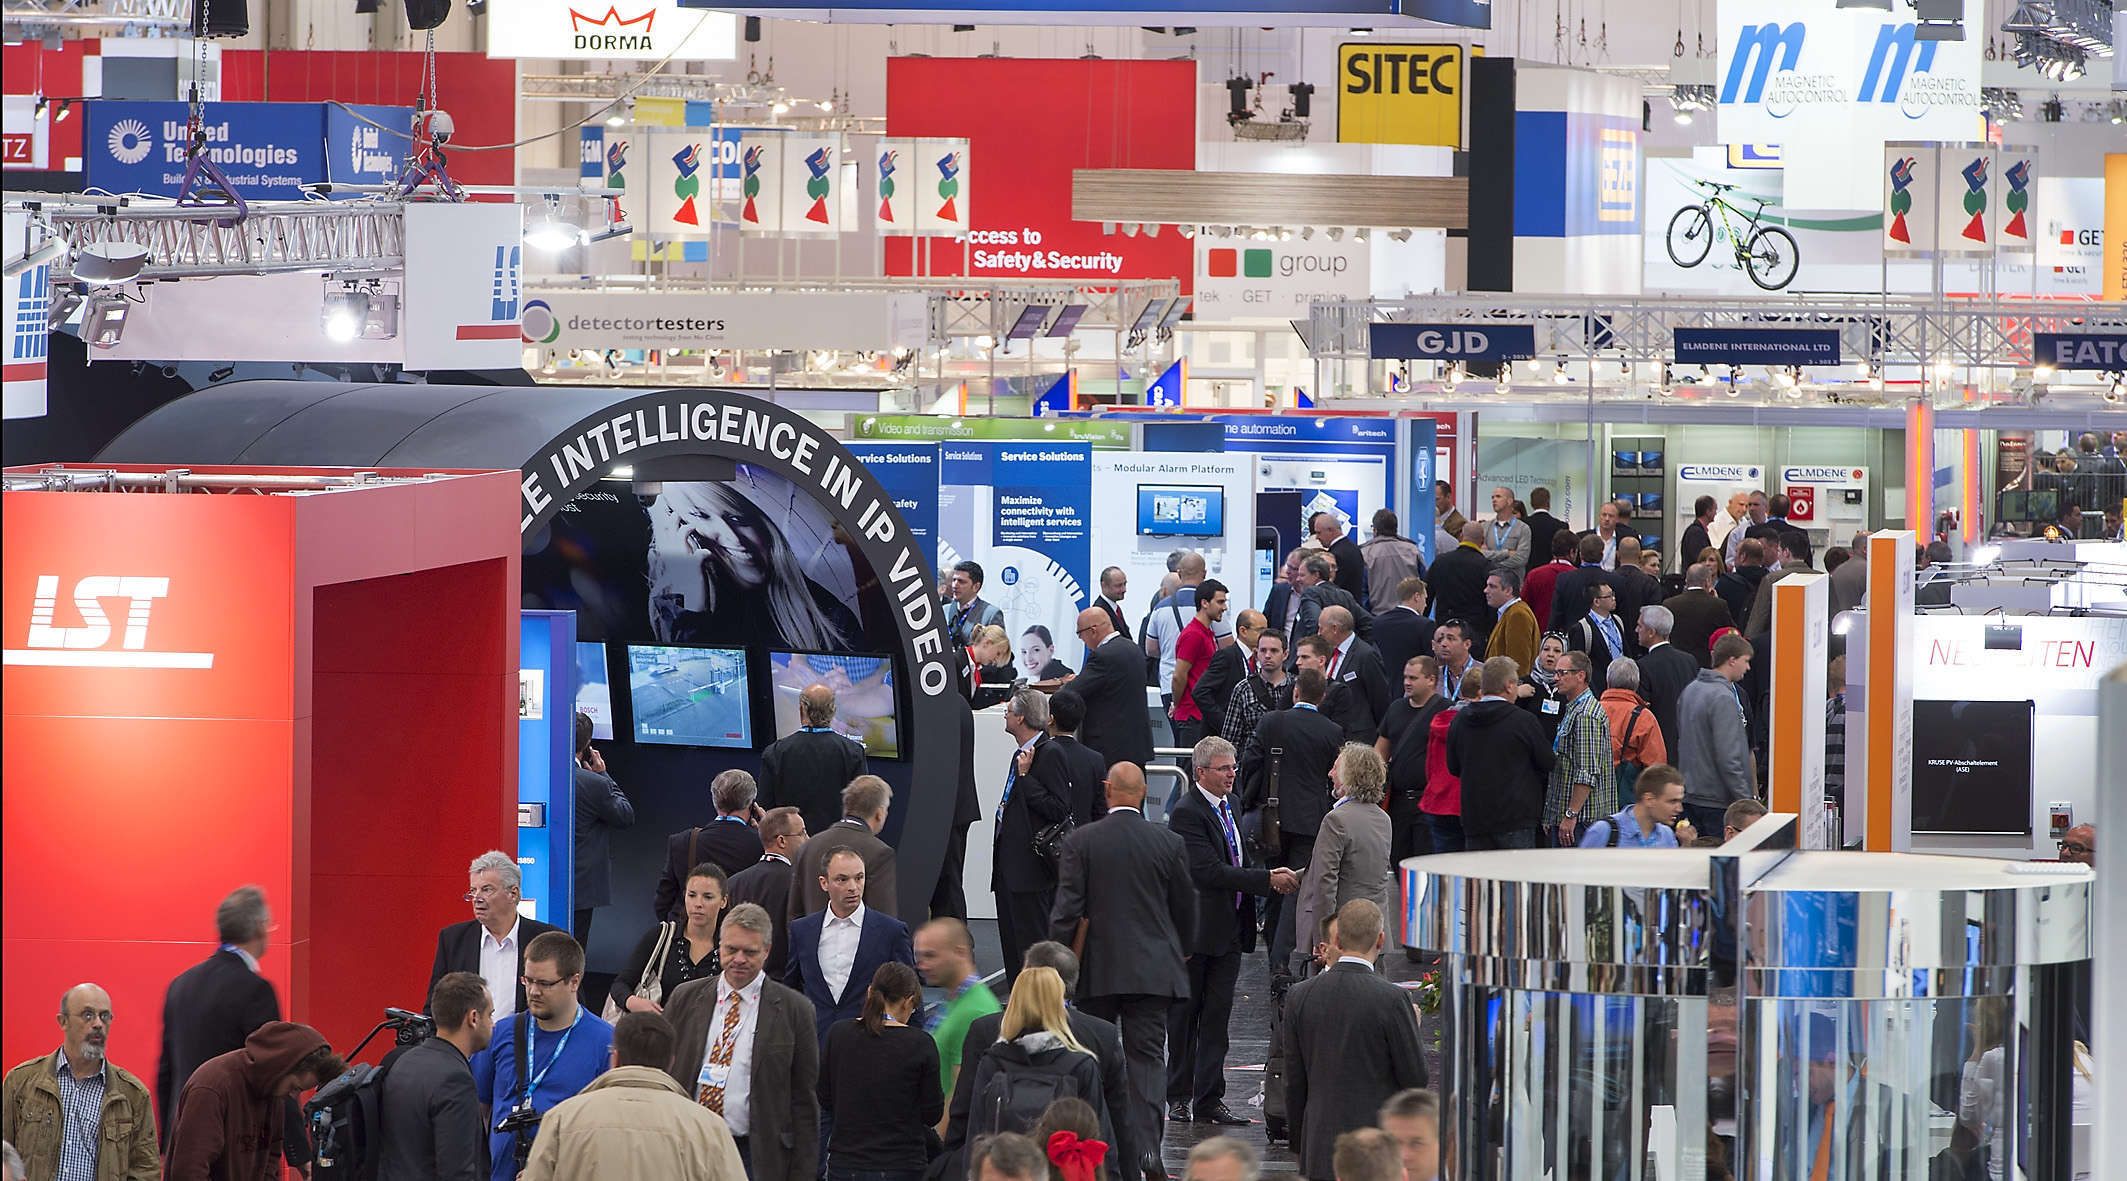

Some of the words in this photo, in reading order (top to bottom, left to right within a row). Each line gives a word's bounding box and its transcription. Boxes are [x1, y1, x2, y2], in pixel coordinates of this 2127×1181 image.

[574, 34, 652, 50] DORMA
[1347, 52, 1454, 95] SITEC
[1774, 75, 1836, 89] MAGNETIC
[1910, 77, 1966, 91] MAGNETIC
[1767, 90, 1849, 104] AUTOCONTROL
[1902, 92, 1979, 107] AUTOCONTROL
[163, 120, 229, 142] Uned
[163, 142, 298, 168] Tenologies
[261, 175, 303, 187] Systems
[1022, 227, 1042, 245] to
[2078, 229, 2105, 246] GE
[1280, 254, 1348, 277] group
[1242, 289, 1273, 303] GET
[567, 314, 725, 331] detectortesters
[1416, 330, 1489, 354] GJD
[1682, 342, 1728, 351] ELMDENE
[1730, 343, 1811, 352] INTERNATIONAL
[1813, 344, 1831, 352] LTD
[878, 422, 902, 435] Video
[903, 423, 921, 436] and
[922, 424, 974, 437] transmission
[1240, 423, 1296, 436] automation
[1357, 429, 1387, 438] aritech
[1074, 433, 1106, 441] truVision
[889, 453, 932, 464] Solutions
[944, 451, 960, 461] Service
[960, 451, 983, 462] Solutions
[1001, 451, 1037, 463] Service
[1038, 451, 1085, 463] Solutions
[1114, 464, 1155, 473] Modular
[1158, 464, 1188, 473] Alarm
[1191, 464, 1235, 474] Platform
[1680, 466, 1743, 482] ELMDENE
[1784, 468, 1847, 483] ELMDENE
[1477, 473, 1514, 483] Advanced
[1515, 475, 1529, 484] LED
[1530, 476, 1557, 487] Technology
[1001, 495, 1043, 505] Maximize
[1000, 506, 1053, 518] connectivity
[1055, 506, 1075, 516] with
[1000, 517, 1045, 528] intelligent
[1046, 517, 1083, 527] services
[549, 402, 820, 489] INTELLIGENCE
[818, 455, 863, 511] IN
[856, 498, 896, 544] IP
[888, 546, 948, 696] VIDEO
[27, 575, 170, 650] LST
[1945, 759, 1998, 767] PV-Abschaltelement
